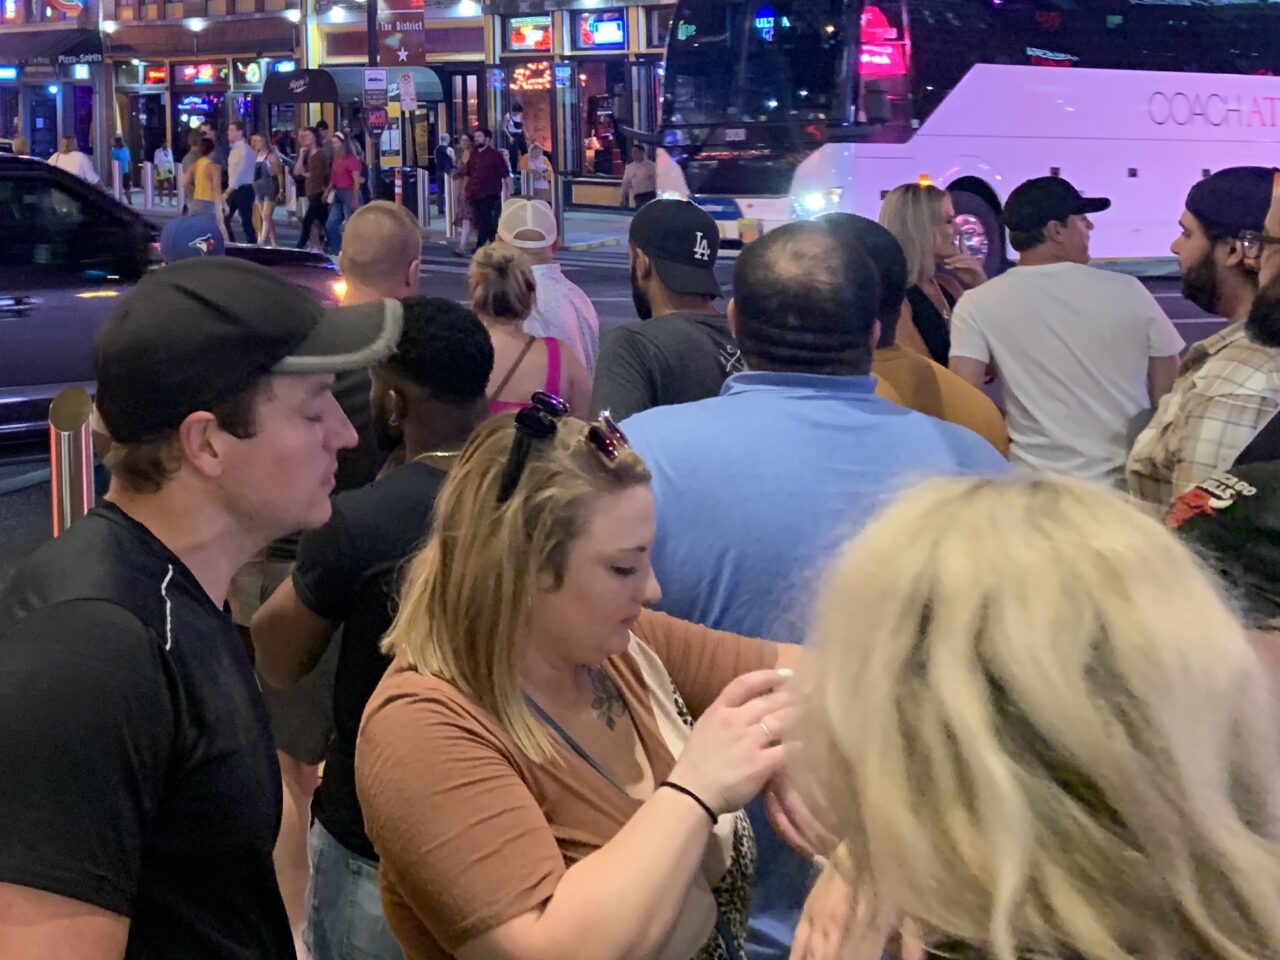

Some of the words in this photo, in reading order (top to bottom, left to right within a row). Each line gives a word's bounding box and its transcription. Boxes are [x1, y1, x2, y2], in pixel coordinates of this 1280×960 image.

[380, 21, 392, 31] The
[395, 20, 424, 31] District
[693, 231, 711, 261] LA
